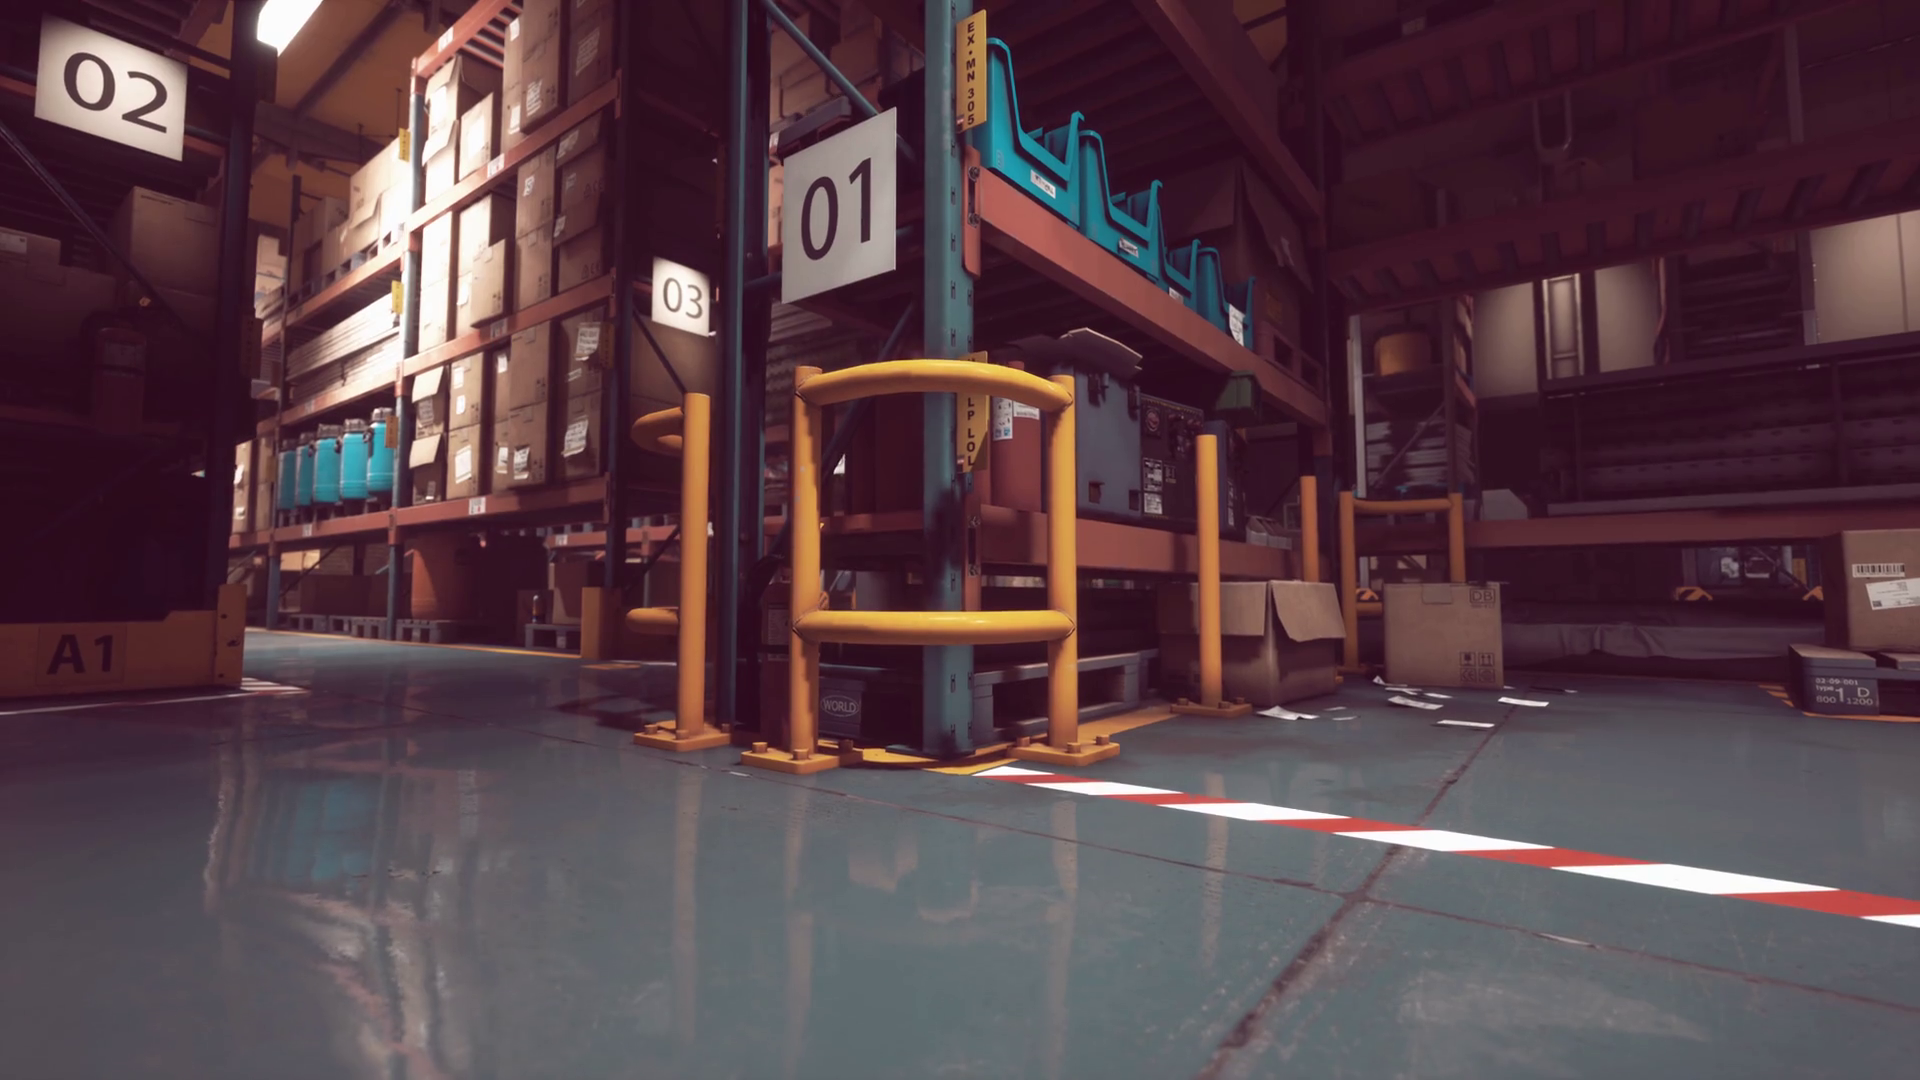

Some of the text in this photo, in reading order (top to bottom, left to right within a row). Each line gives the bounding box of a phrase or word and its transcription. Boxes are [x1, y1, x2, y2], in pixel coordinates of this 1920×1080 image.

[63, 51, 168, 134] 02
[967, 88, 975, 125] 305
[801, 157, 872, 261] 01
[662, 277, 703, 320] 03
[966, 428, 976, 467] LOL
[46, 633, 113, 676] A1
[823, 699, 857, 713] WORLD
[1816, 695, 1873, 705] 800 1200
[1835, 687, 1844, 702] 1
[1857, 687, 1870, 698] D
